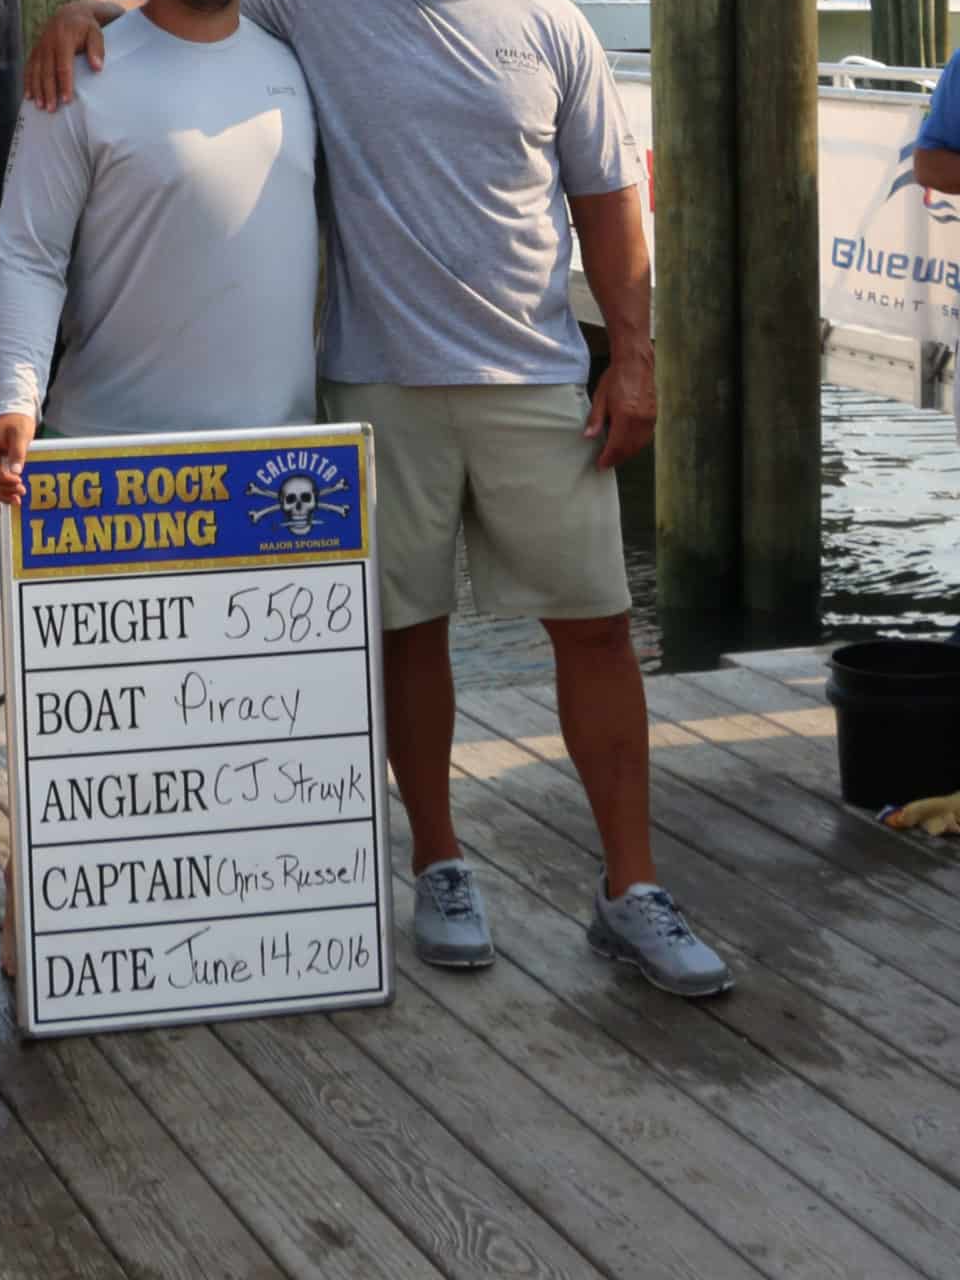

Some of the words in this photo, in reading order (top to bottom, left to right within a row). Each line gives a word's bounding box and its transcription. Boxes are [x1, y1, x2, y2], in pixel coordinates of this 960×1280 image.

[28, 471, 103, 511] BIG
[115, 464, 229, 507] ROCK
[256, 450, 338, 485] CALCUTTA
[29, 510, 218, 555] LANDING
[259, 540, 293, 552] MAJOR
[32, 595, 195, 649] WEIGHT
[224, 582, 353, 644] 558.8
[36, 685, 146, 736] BOAT
[174, 671, 300, 735] Piracy
[40, 768, 208, 824] ANGLER
[273, 761, 366, 813] Struyk
[41, 854, 213, 912] CAPTAIN
[216, 856, 275, 902] Chris
[276, 847, 367, 894] Russell
[45, 947, 156, 1000] DATE
[164, 925, 253, 990] June
